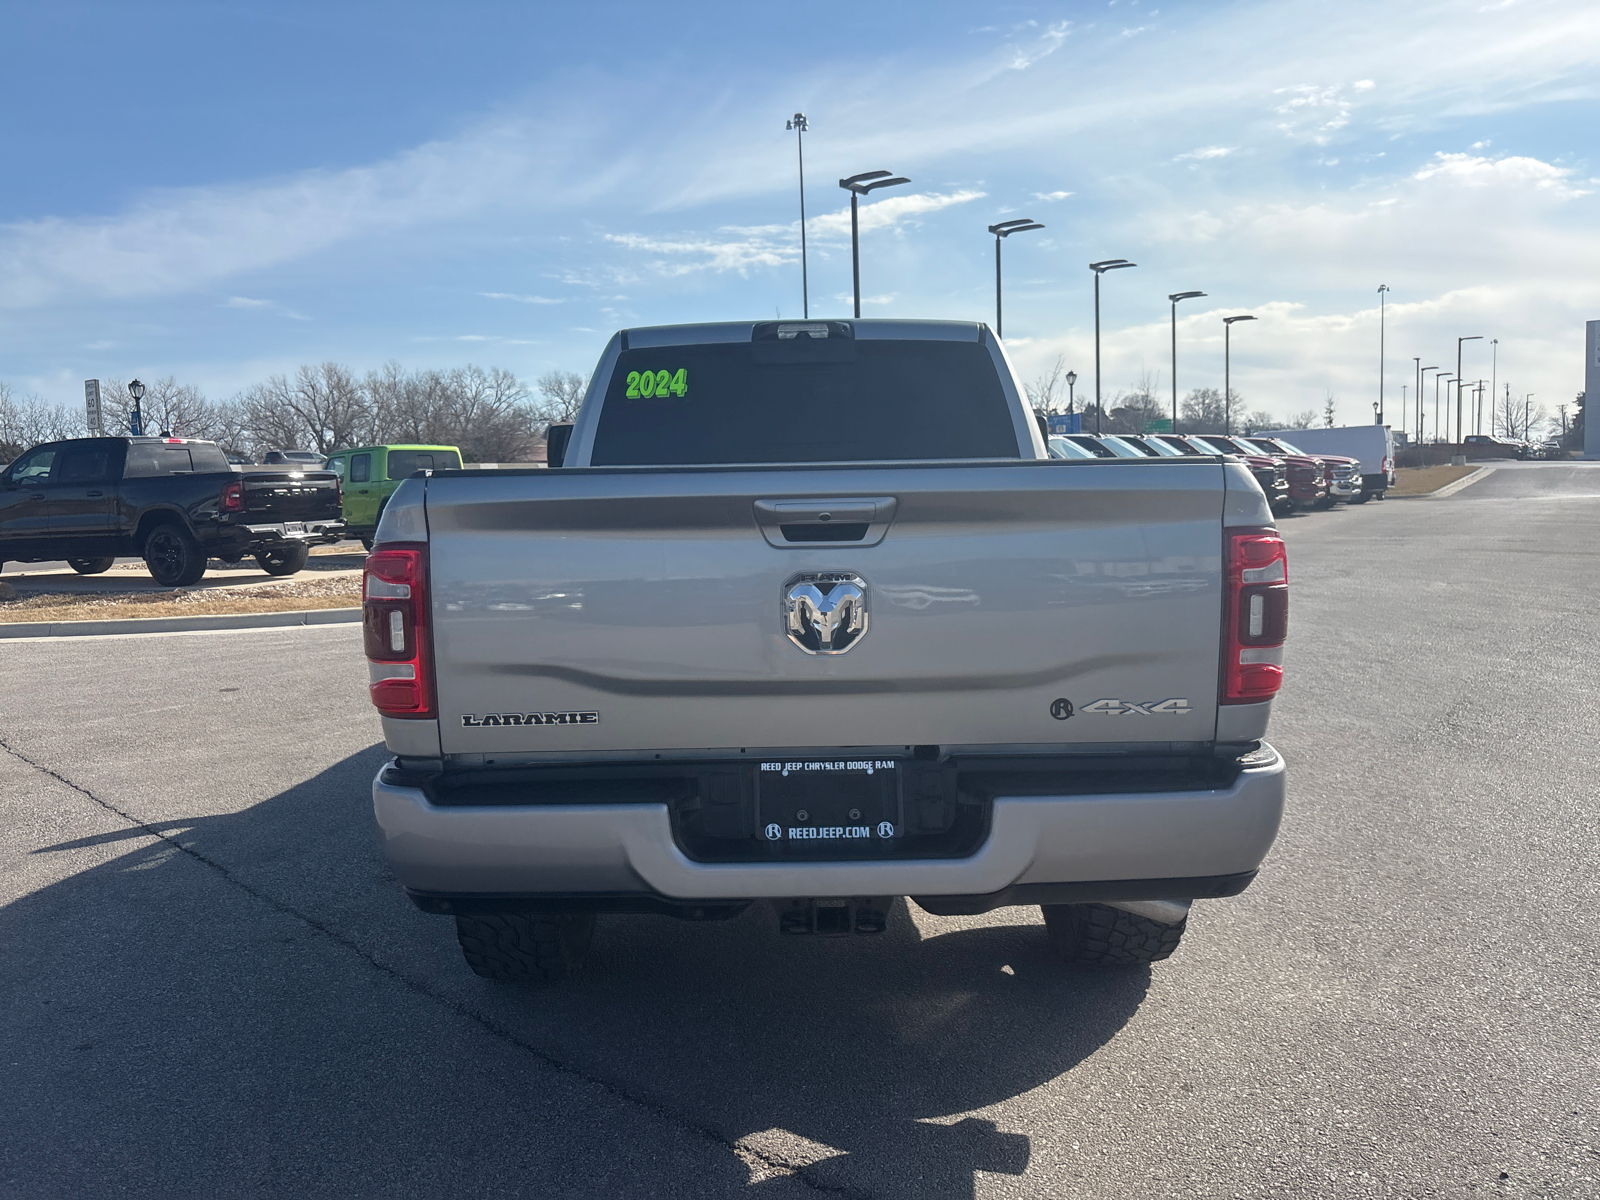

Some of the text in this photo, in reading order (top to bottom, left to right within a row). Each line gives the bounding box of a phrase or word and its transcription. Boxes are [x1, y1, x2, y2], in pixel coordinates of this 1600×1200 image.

[626, 368, 688, 399] 2024
[800, 573, 852, 582] RAM
[461, 710, 600, 728] LARAMIE
[760, 760, 895, 771] REED JEEP CHRYSLER DODGE RAM
[788, 826, 870, 839] REEDJEEP.COM
